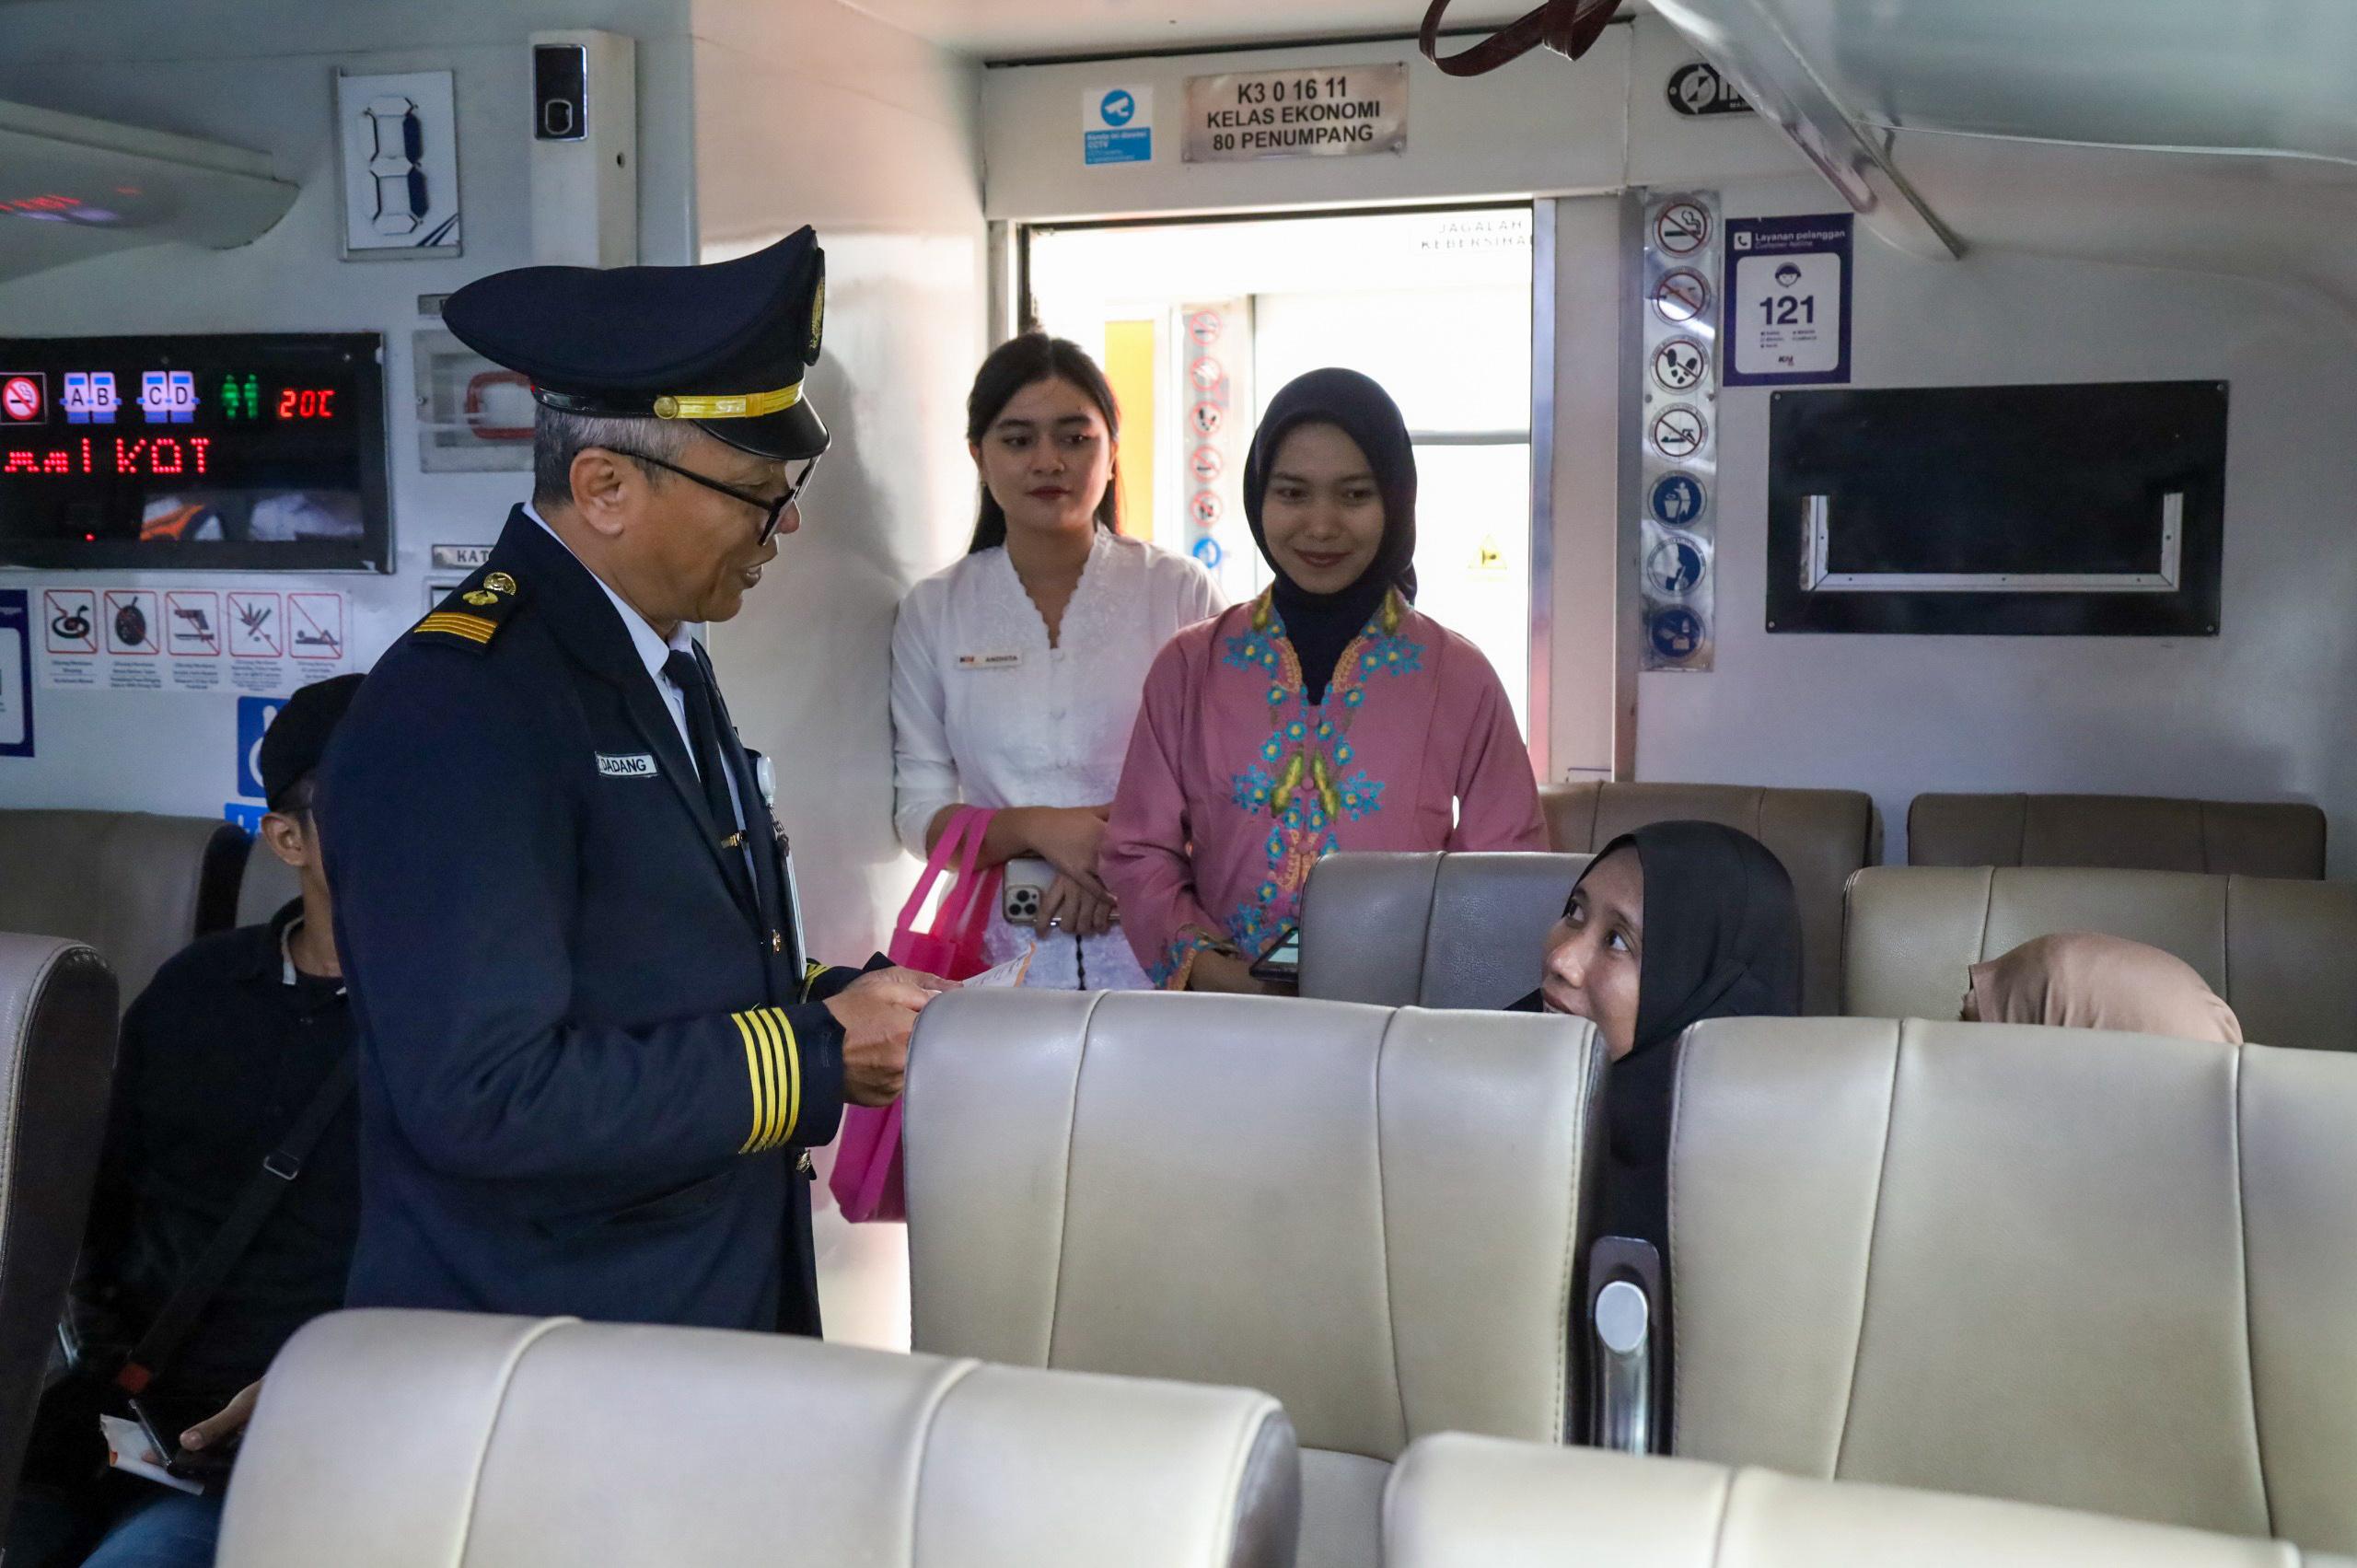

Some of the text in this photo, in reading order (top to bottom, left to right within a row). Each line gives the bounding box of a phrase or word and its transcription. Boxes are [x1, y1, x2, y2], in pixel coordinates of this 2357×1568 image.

[1237, 82, 1266, 105] K3
[1272, 80, 1286, 102] 0
[1207, 100, 1380, 129] KELAS EKONOMI
[1213, 123, 1374, 151] 80 PENUMPANG
[1421, 236, 1532, 250] KEBERSIHA
[1755, 229, 1845, 243] Layanan pelanggan
[1759, 295, 1814, 324] 121
[70, 387, 84, 406] A
[96, 387, 109, 406] B
[148, 386, 161, 405] C
[175, 386, 188, 405] D
[457, 550, 489, 563] KAT
[600, 758, 646, 772] DADANG
